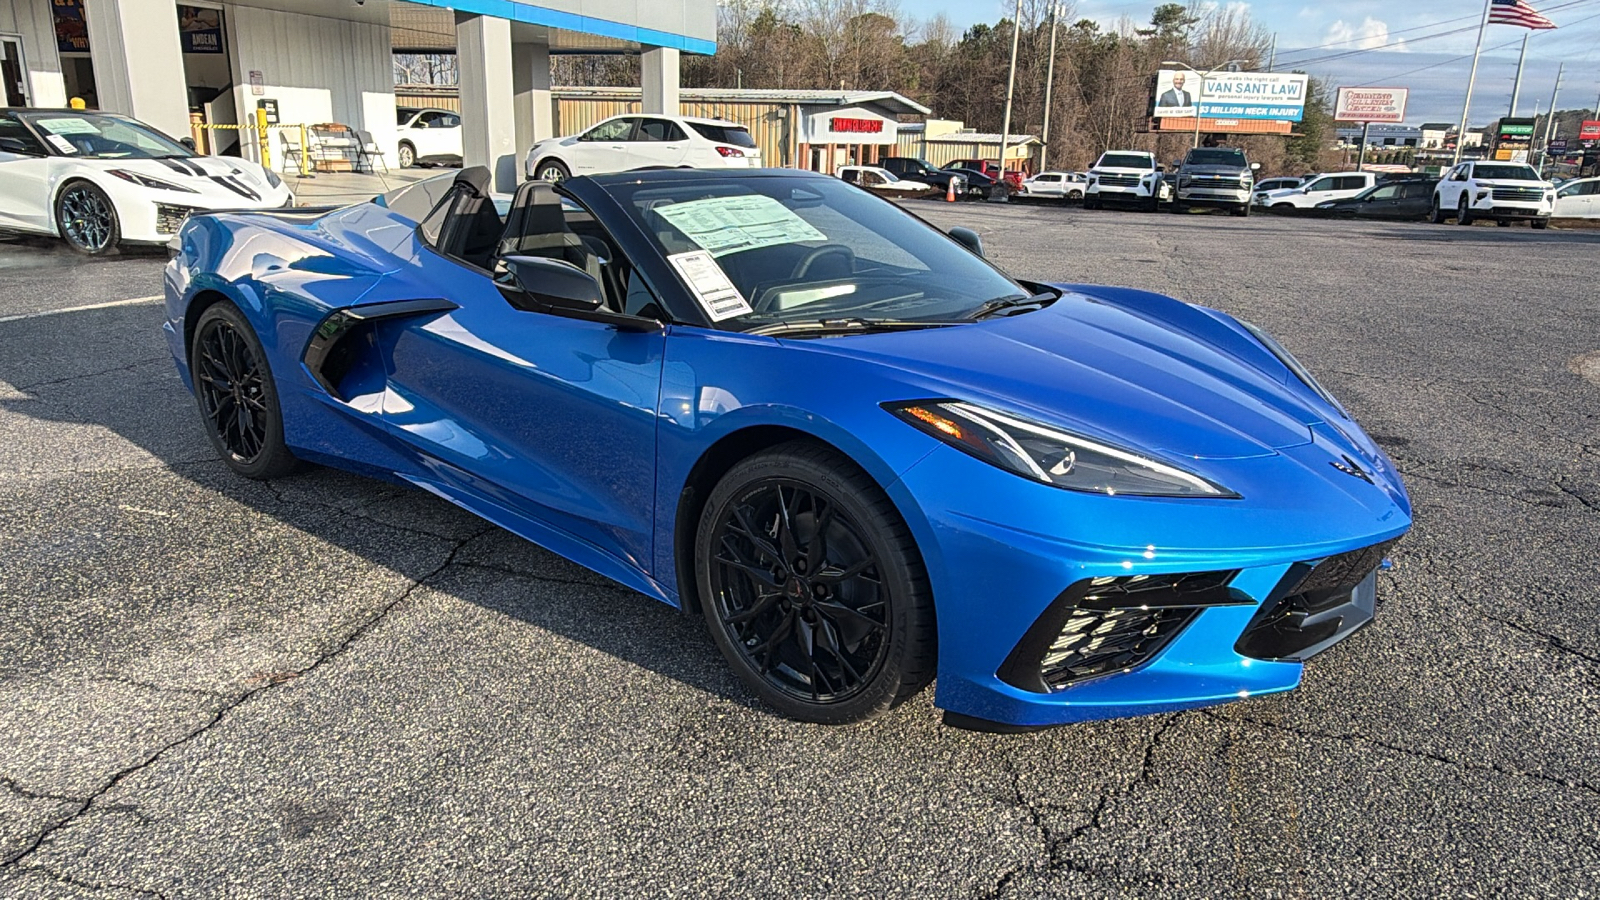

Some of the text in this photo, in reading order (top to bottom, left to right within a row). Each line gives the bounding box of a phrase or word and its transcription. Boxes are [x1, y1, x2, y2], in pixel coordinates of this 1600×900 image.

[1208, 82, 1298, 95] VAN SANT LAW
[1210, 106, 1244, 115] MILLION
[1244, 107, 1268, 116] NECK
[1269, 108, 1300, 117] INJURY
